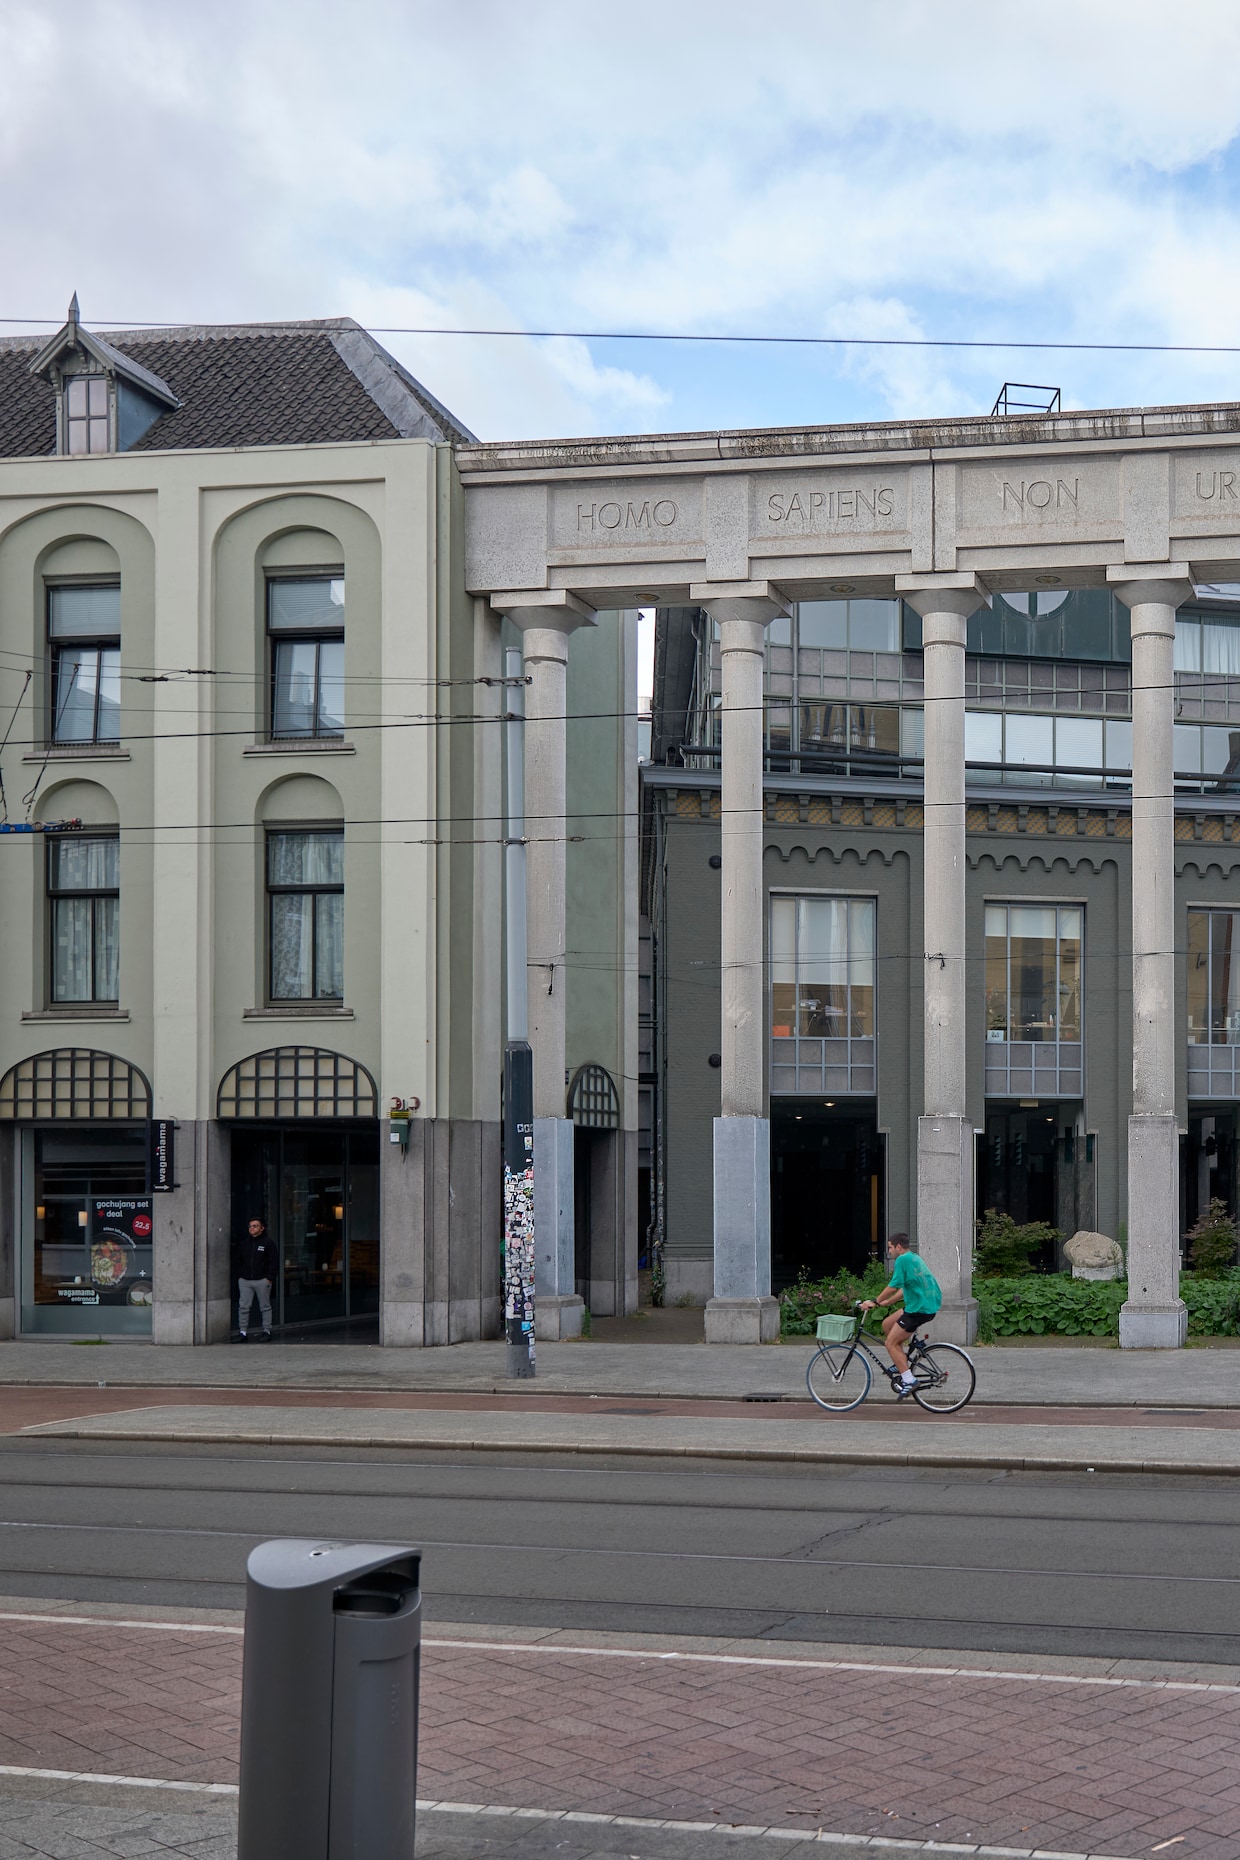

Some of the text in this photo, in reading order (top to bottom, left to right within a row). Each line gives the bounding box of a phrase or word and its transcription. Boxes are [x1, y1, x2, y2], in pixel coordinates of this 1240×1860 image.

[577, 499, 680, 531] HOMO
[767, 488, 895, 521] SAPIENS
[1002, 478, 1079, 511] NON
[159, 1122, 167, 1183] wagamama
[96, 1199, 149, 1209] gochujang set
[106, 1210, 123, 1218] deal
[57, 1289, 95, 1297] wagamama
